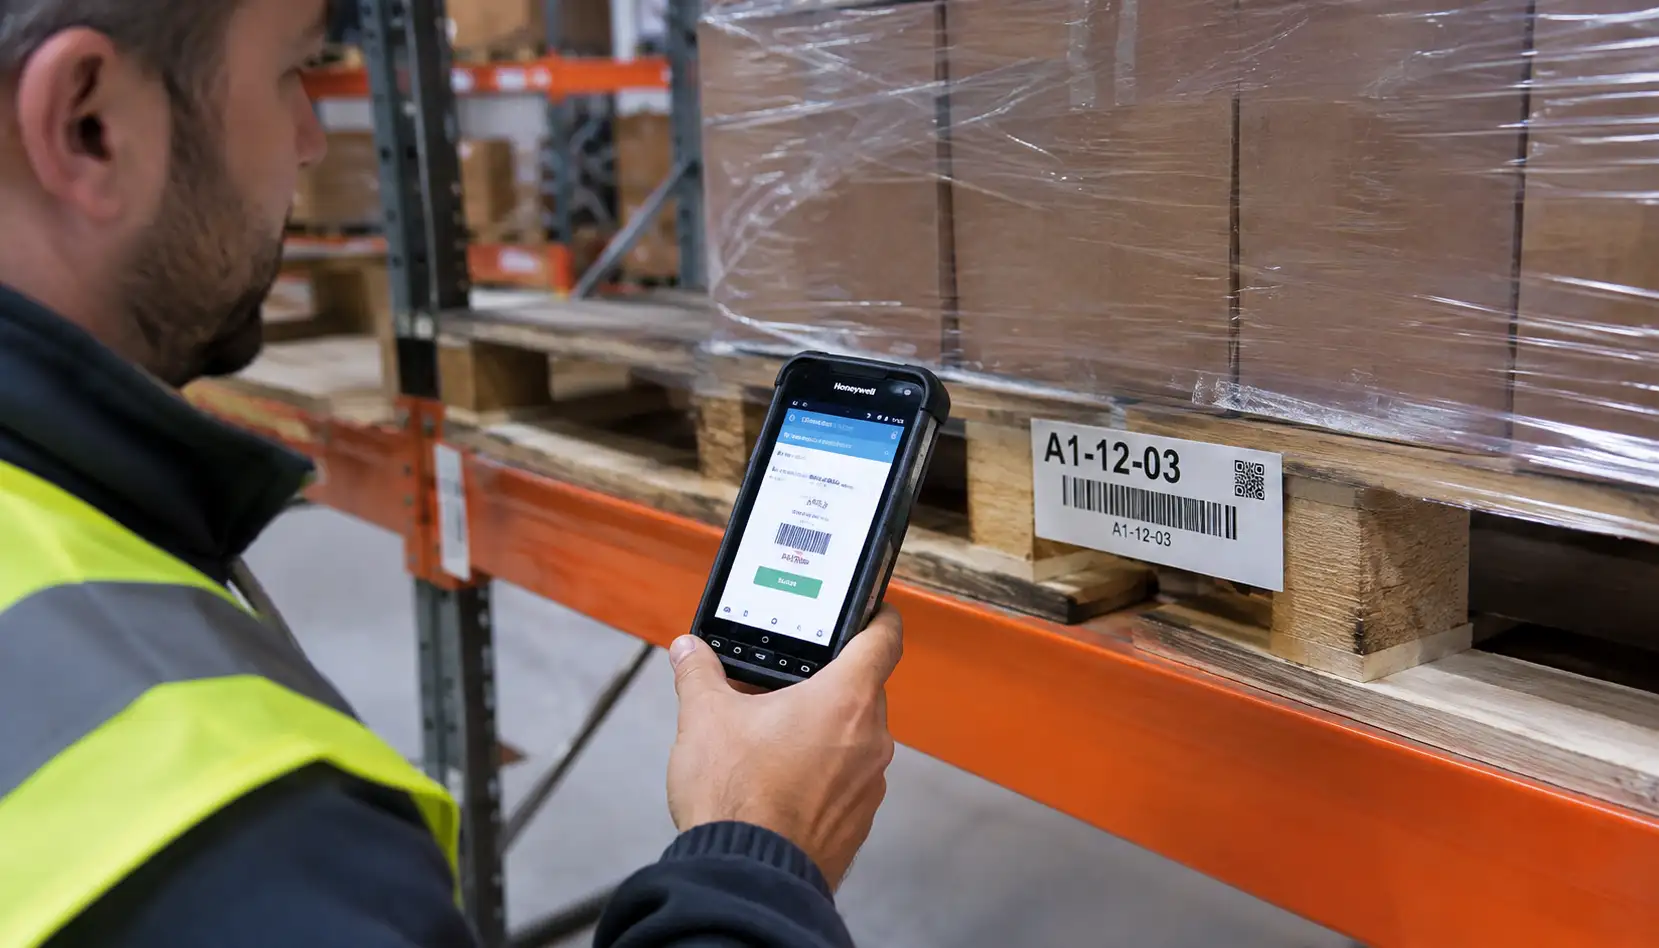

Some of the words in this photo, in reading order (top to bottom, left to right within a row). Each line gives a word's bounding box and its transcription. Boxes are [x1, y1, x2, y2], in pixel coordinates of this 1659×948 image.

[833, 382, 877, 396] Honeywell
[1044, 432, 1181, 483] A1-12-03
[1112, 521, 1172, 547] A1-12-03
